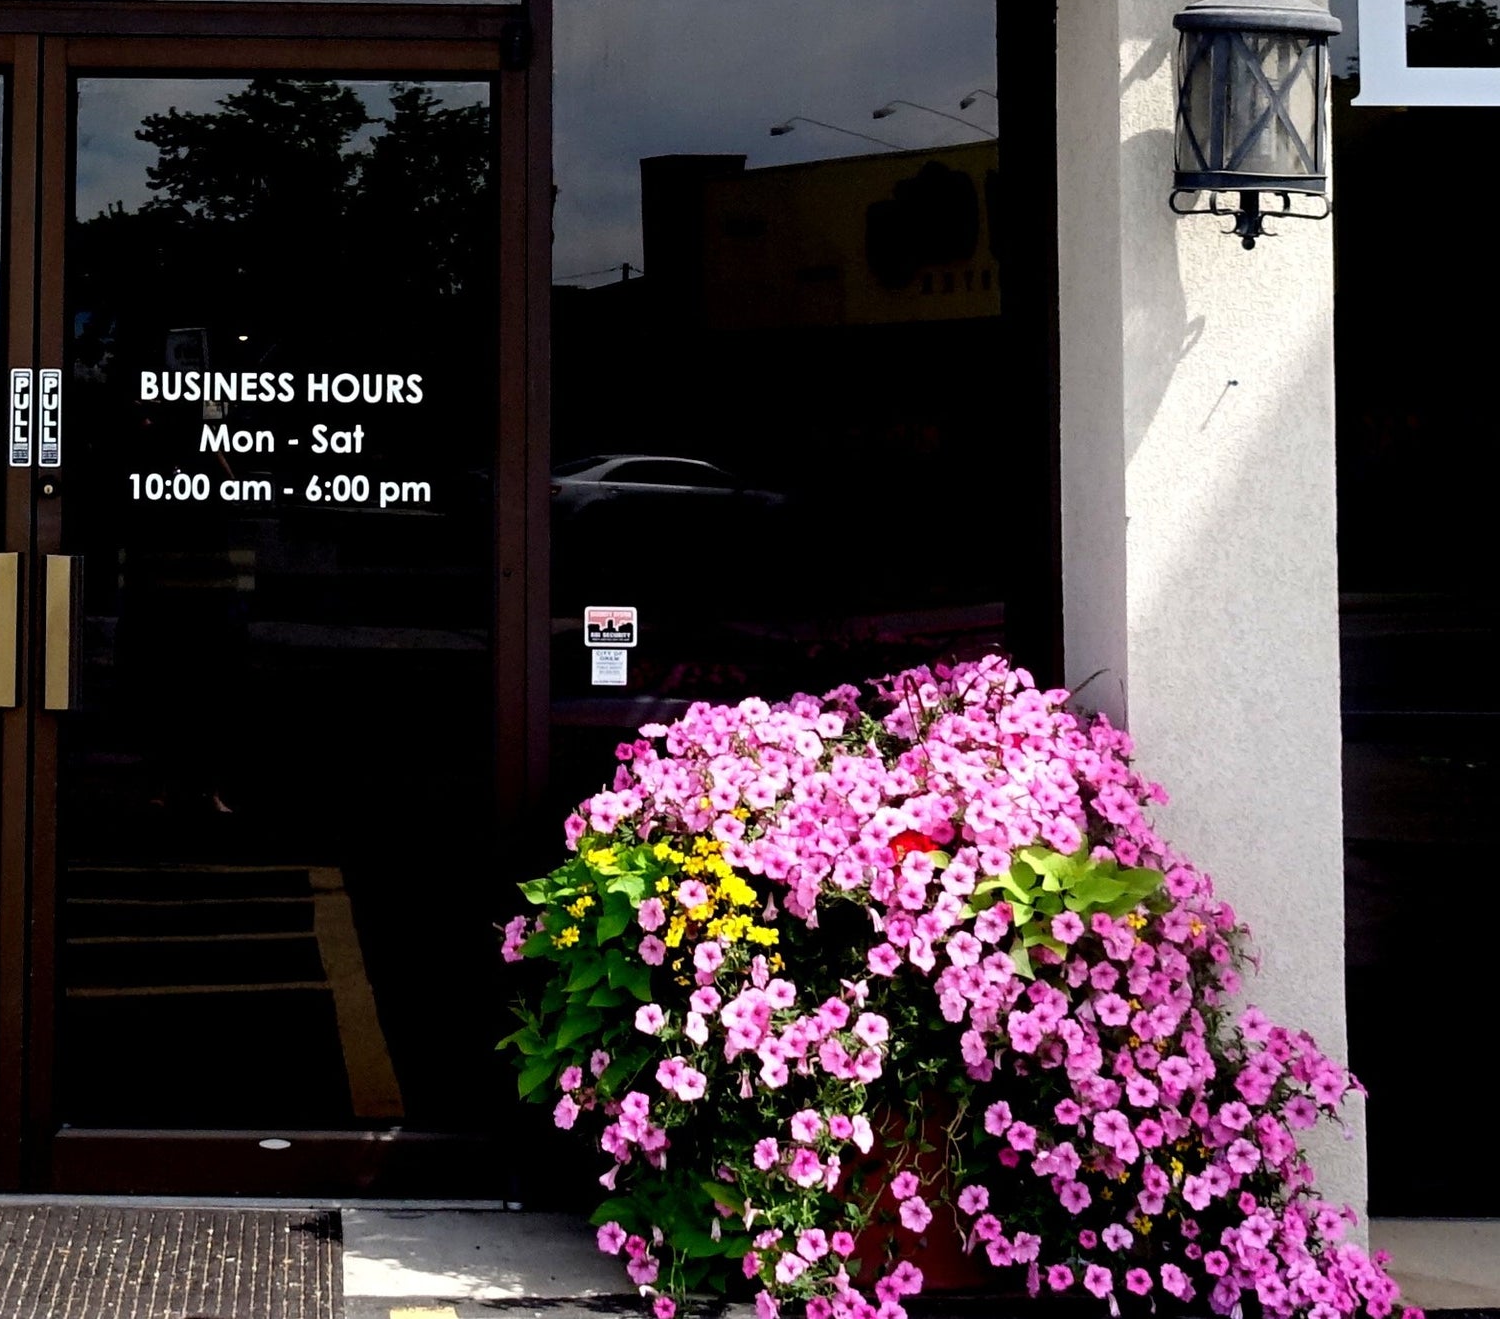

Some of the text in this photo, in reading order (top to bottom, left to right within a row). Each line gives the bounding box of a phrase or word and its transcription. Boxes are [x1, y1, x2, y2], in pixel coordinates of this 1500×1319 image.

[140, 371, 424, 404] BUSINESS HOURS
[14, 377, 30, 443] PULL
[42, 377, 59, 443] PULL
[199, 423, 276, 453] Mon
[311, 424, 365, 454] Sat
[129, 473, 211, 501] 10:00
[219, 480, 273, 502] am
[305, 474, 371, 503] 6:00
[379, 481, 432, 509] pm
